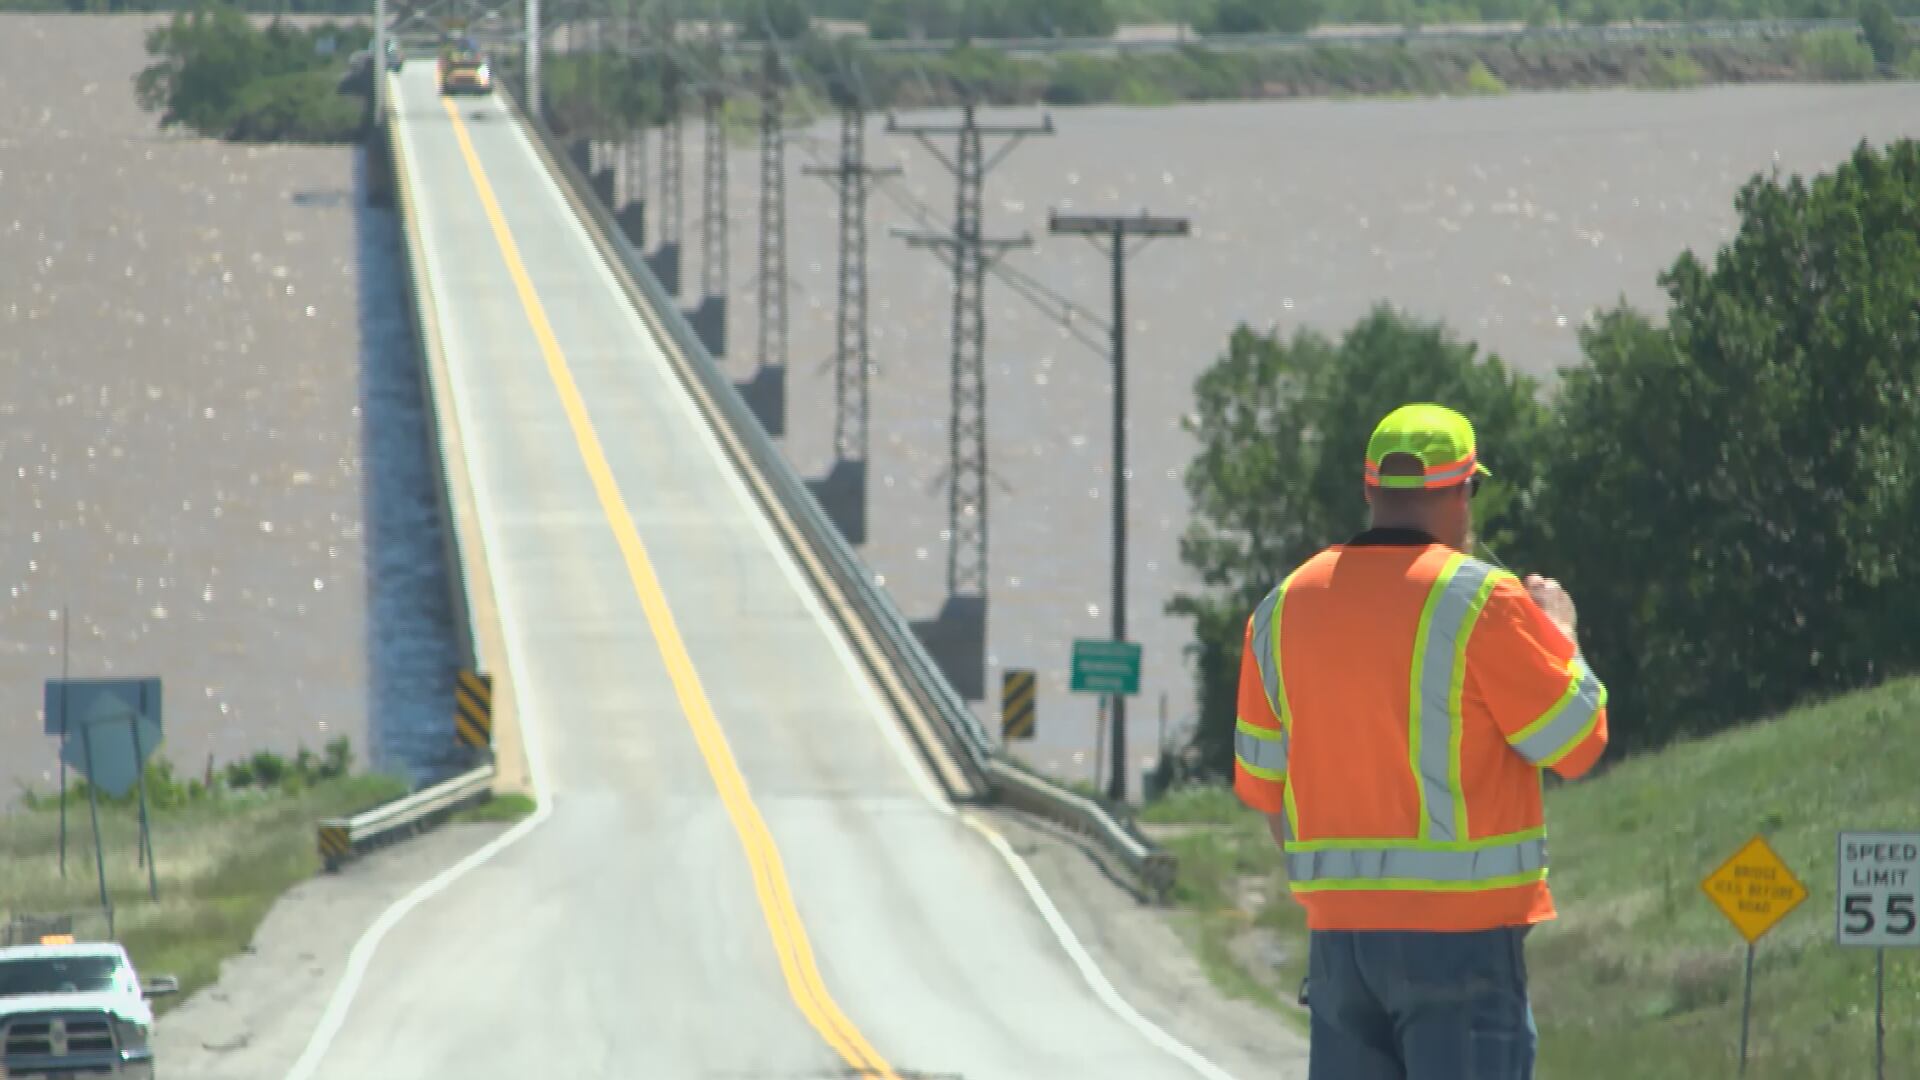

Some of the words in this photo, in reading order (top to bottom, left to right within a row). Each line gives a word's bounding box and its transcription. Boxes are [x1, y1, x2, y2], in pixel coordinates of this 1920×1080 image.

[1846, 843, 1917, 862] SPEED
[1853, 869, 1908, 887] LIMIT
[1844, 893, 1917, 935] 55
